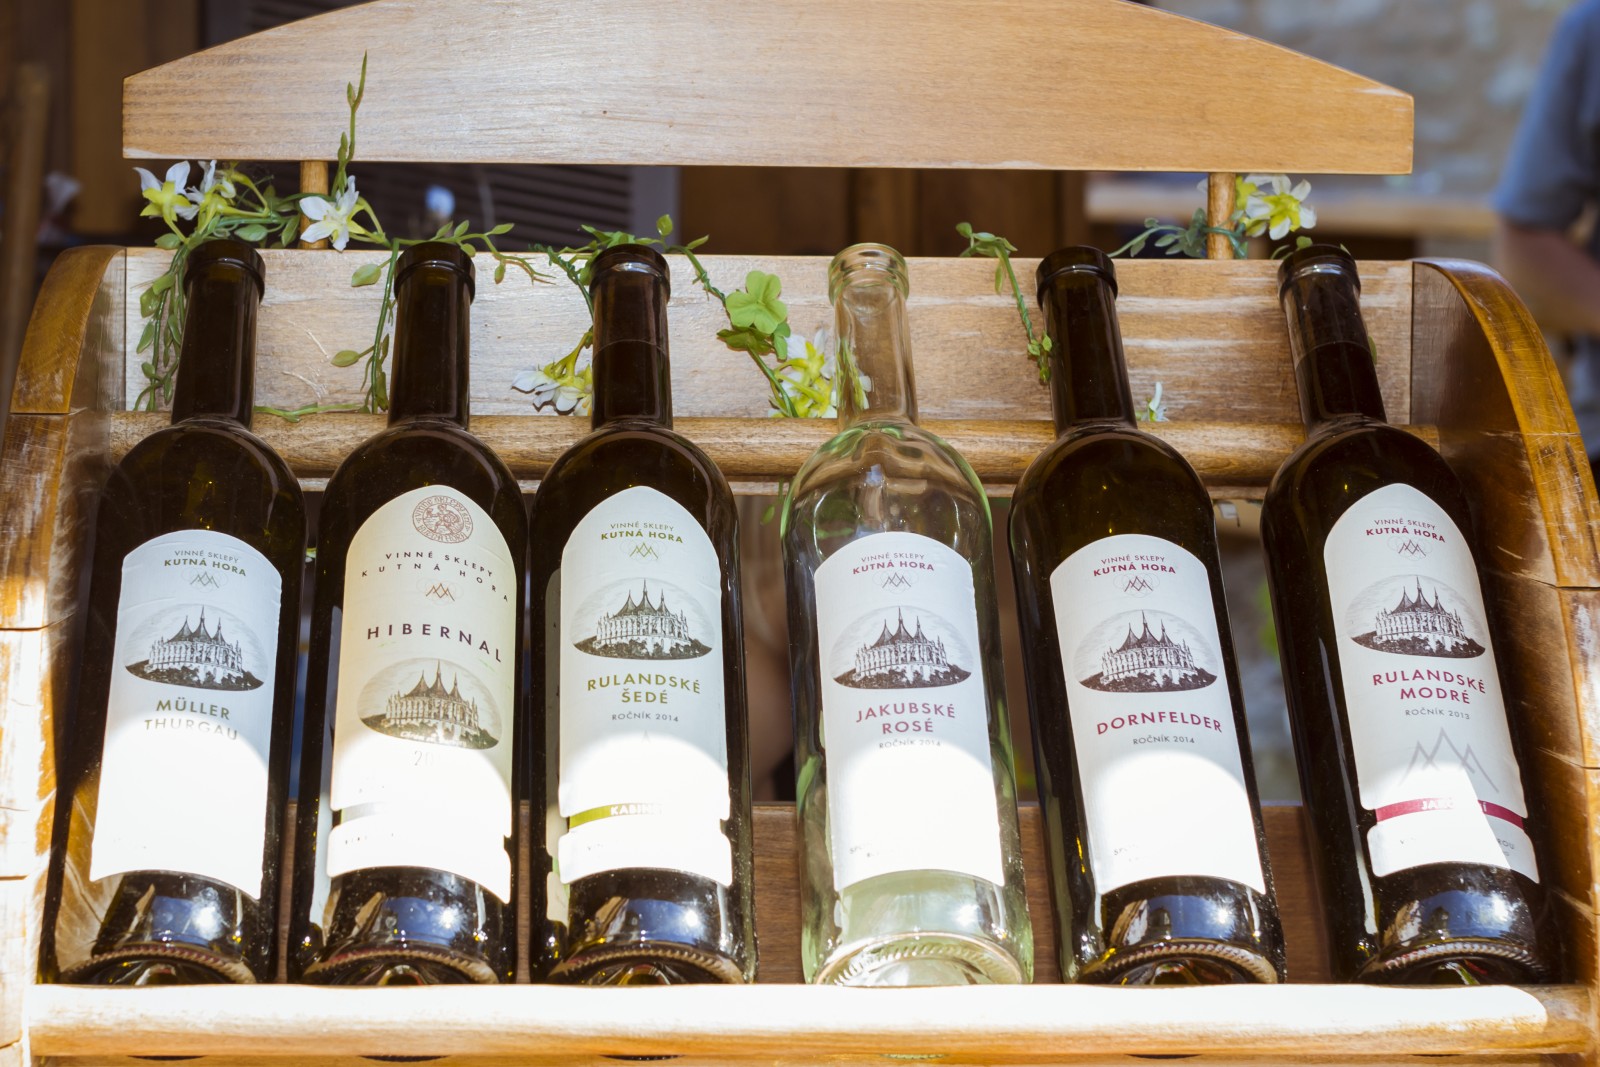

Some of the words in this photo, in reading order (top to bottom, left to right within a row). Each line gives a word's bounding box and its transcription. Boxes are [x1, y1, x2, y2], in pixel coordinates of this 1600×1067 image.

[610, 520, 639, 529] VINNÉ
[643, 522, 674, 532] SKLEPY
[1374, 517, 1404, 525] VINNÉ
[1407, 519, 1436, 531] SKLEPY
[601, 528, 643, 541] KUTNÁ
[649, 531, 684, 544] HORA
[1366, 525, 1409, 536] KUTNÁ
[1414, 528, 1446, 543] HORA
[174, 549, 204, 557] VINNÉ
[207, 551, 239, 563] SKLEPY
[386, 551, 433, 560] VINNÉ
[444, 554, 493, 577] SKLEPY
[861, 551, 890, 563] VINNÉ
[893, 552, 925, 560] SKLEPY
[1101, 554, 1131, 565] VINNÉ
[1134, 554, 1166, 563] SKLEPY
[164, 557, 207, 567] KUTNÁ
[212, 560, 247, 577] HORA
[852, 560, 895, 575] KUTNÁ
[900, 560, 935, 571] HORA
[1093, 562, 1137, 577] KUTNÁ
[1141, 563, 1177, 574] HORA
[361, 563, 440, 577] KUTNÁ
[459, 569, 508, 602] HORA
[367, 623, 501, 662] HIBERNAL
[587, 673, 701, 694] RULANDSKÉ
[1372, 669, 1486, 694] RULANDSKÉ
[621, 688, 669, 704] ŠEDÉ
[1400, 686, 1471, 704] MODRÉ
[156, 697, 231, 720] MÜLLER
[611, 710, 651, 721] ROČNÍK
[656, 713, 679, 722] 2014
[856, 702, 956, 723] JAKUBSKÉ
[1405, 707, 1445, 716] ROČNÍK
[1449, 710, 1471, 720] 2013
[144, 718, 238, 740] THURGAU
[882, 717, 934, 734] ROSÉ
[1097, 711, 1223, 735] DORNFELDER
[1133, 734, 1170, 745] ROČNÍK
[1173, 735, 1195, 744] 2014
